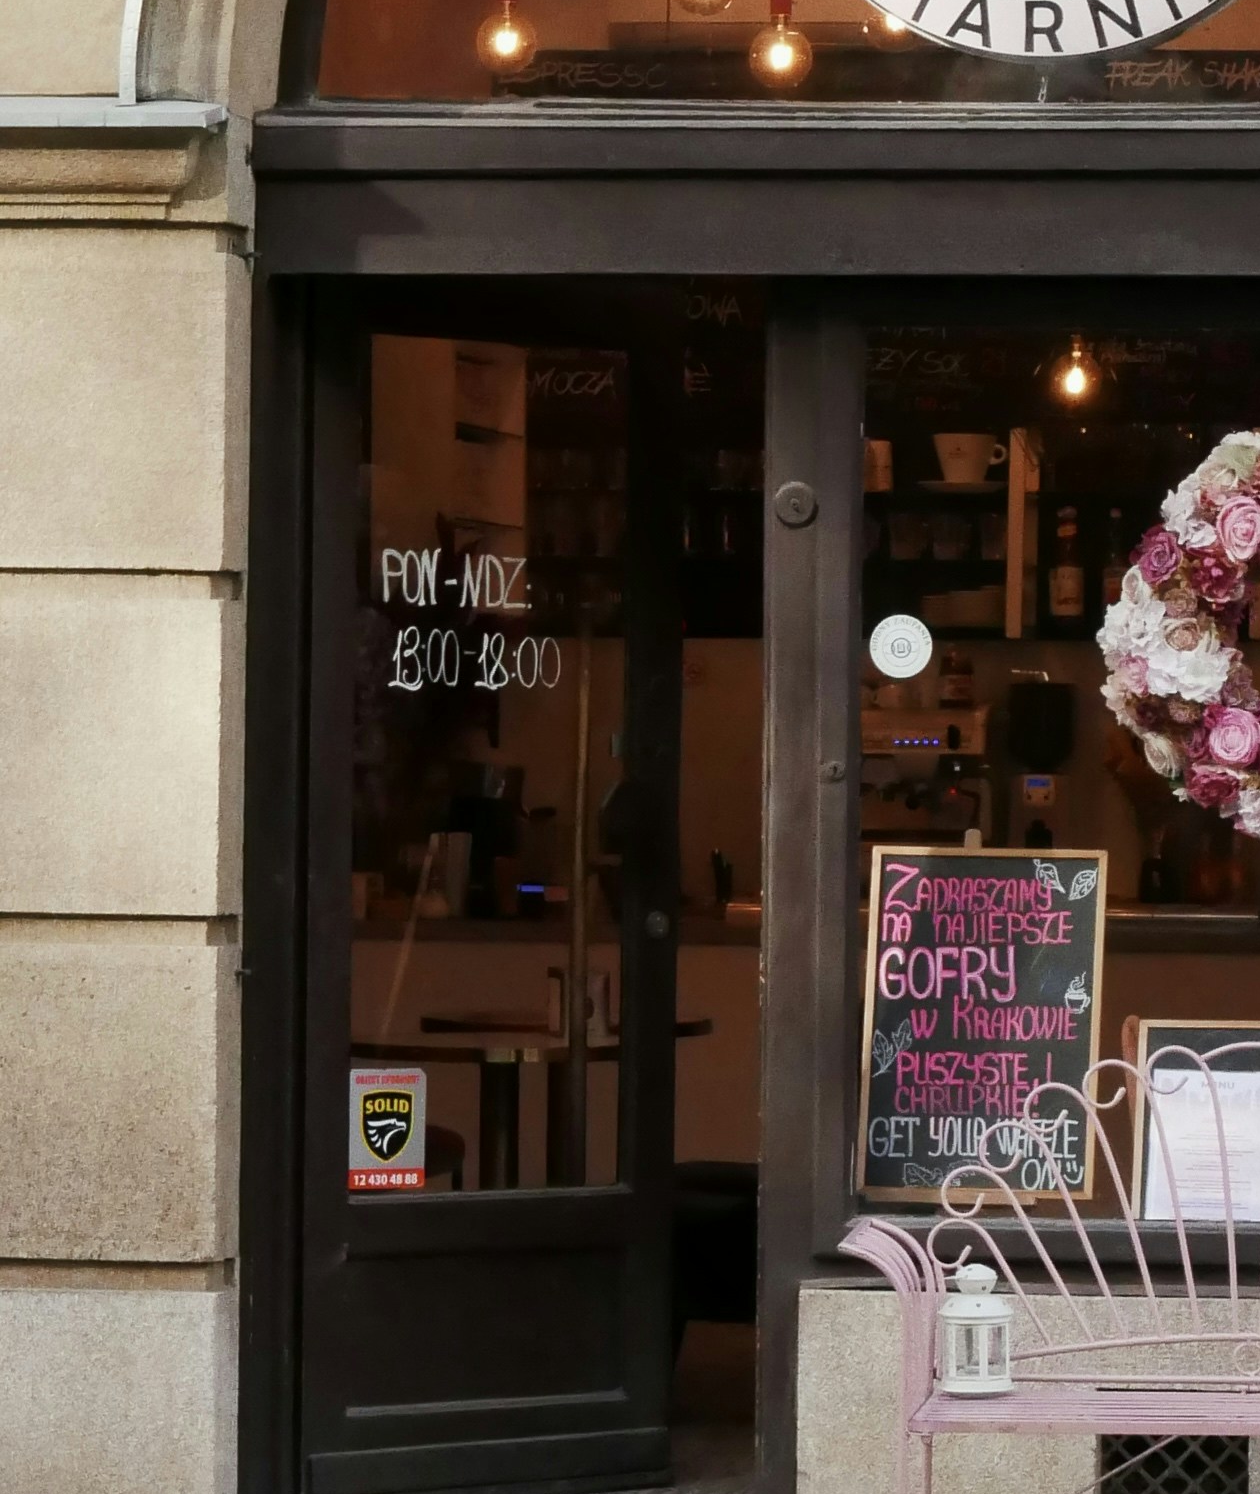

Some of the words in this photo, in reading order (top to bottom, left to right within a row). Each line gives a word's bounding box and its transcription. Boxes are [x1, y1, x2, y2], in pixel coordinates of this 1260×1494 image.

[1104, 58, 1192, 91] FREAK
[527, 365, 616, 399] MOCZA
[879, 945, 1017, 1003] GOFRY
[953, 994, 1078, 1041] KRAKOWIE
[1201, 1081, 1235, 1090] MNU
[365, 1099, 409, 1114] SOLID
[868, 1116, 920, 1158] GET
[928, 1116, 990, 1157] YOUR
[996, 1118, 1079, 1159] WAFFLE
[354, 1174, 366, 1186] 12
[368, 1174, 388, 1185] 430
